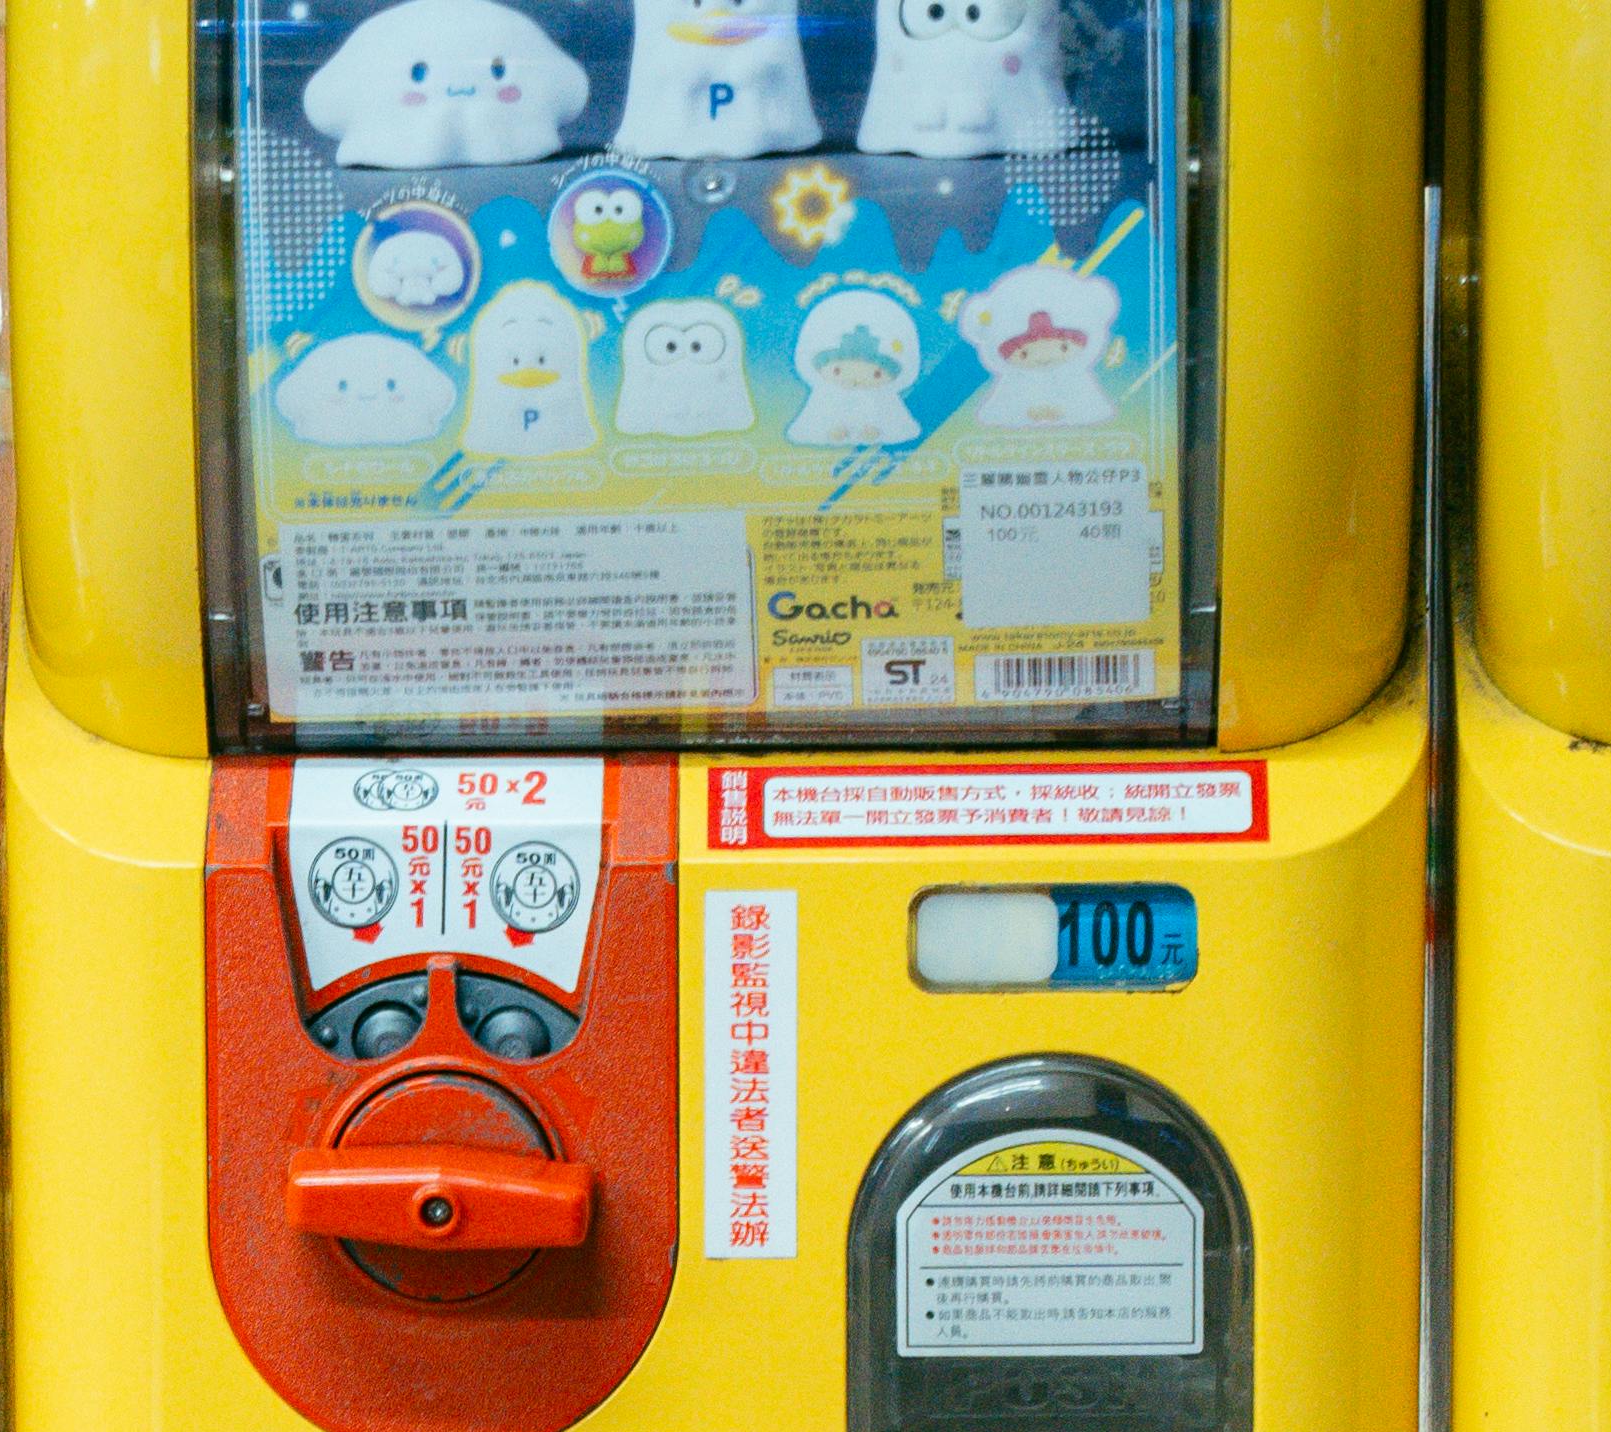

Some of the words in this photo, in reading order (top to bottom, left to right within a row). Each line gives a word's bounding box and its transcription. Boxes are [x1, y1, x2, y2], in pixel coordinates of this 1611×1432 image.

[980, 500, 1124, 521] NO.001243193
[294, 598, 469, 626] 使用注意事項
[767, 591, 899, 621] Gacha
[298, 649, 356, 673] 警告
